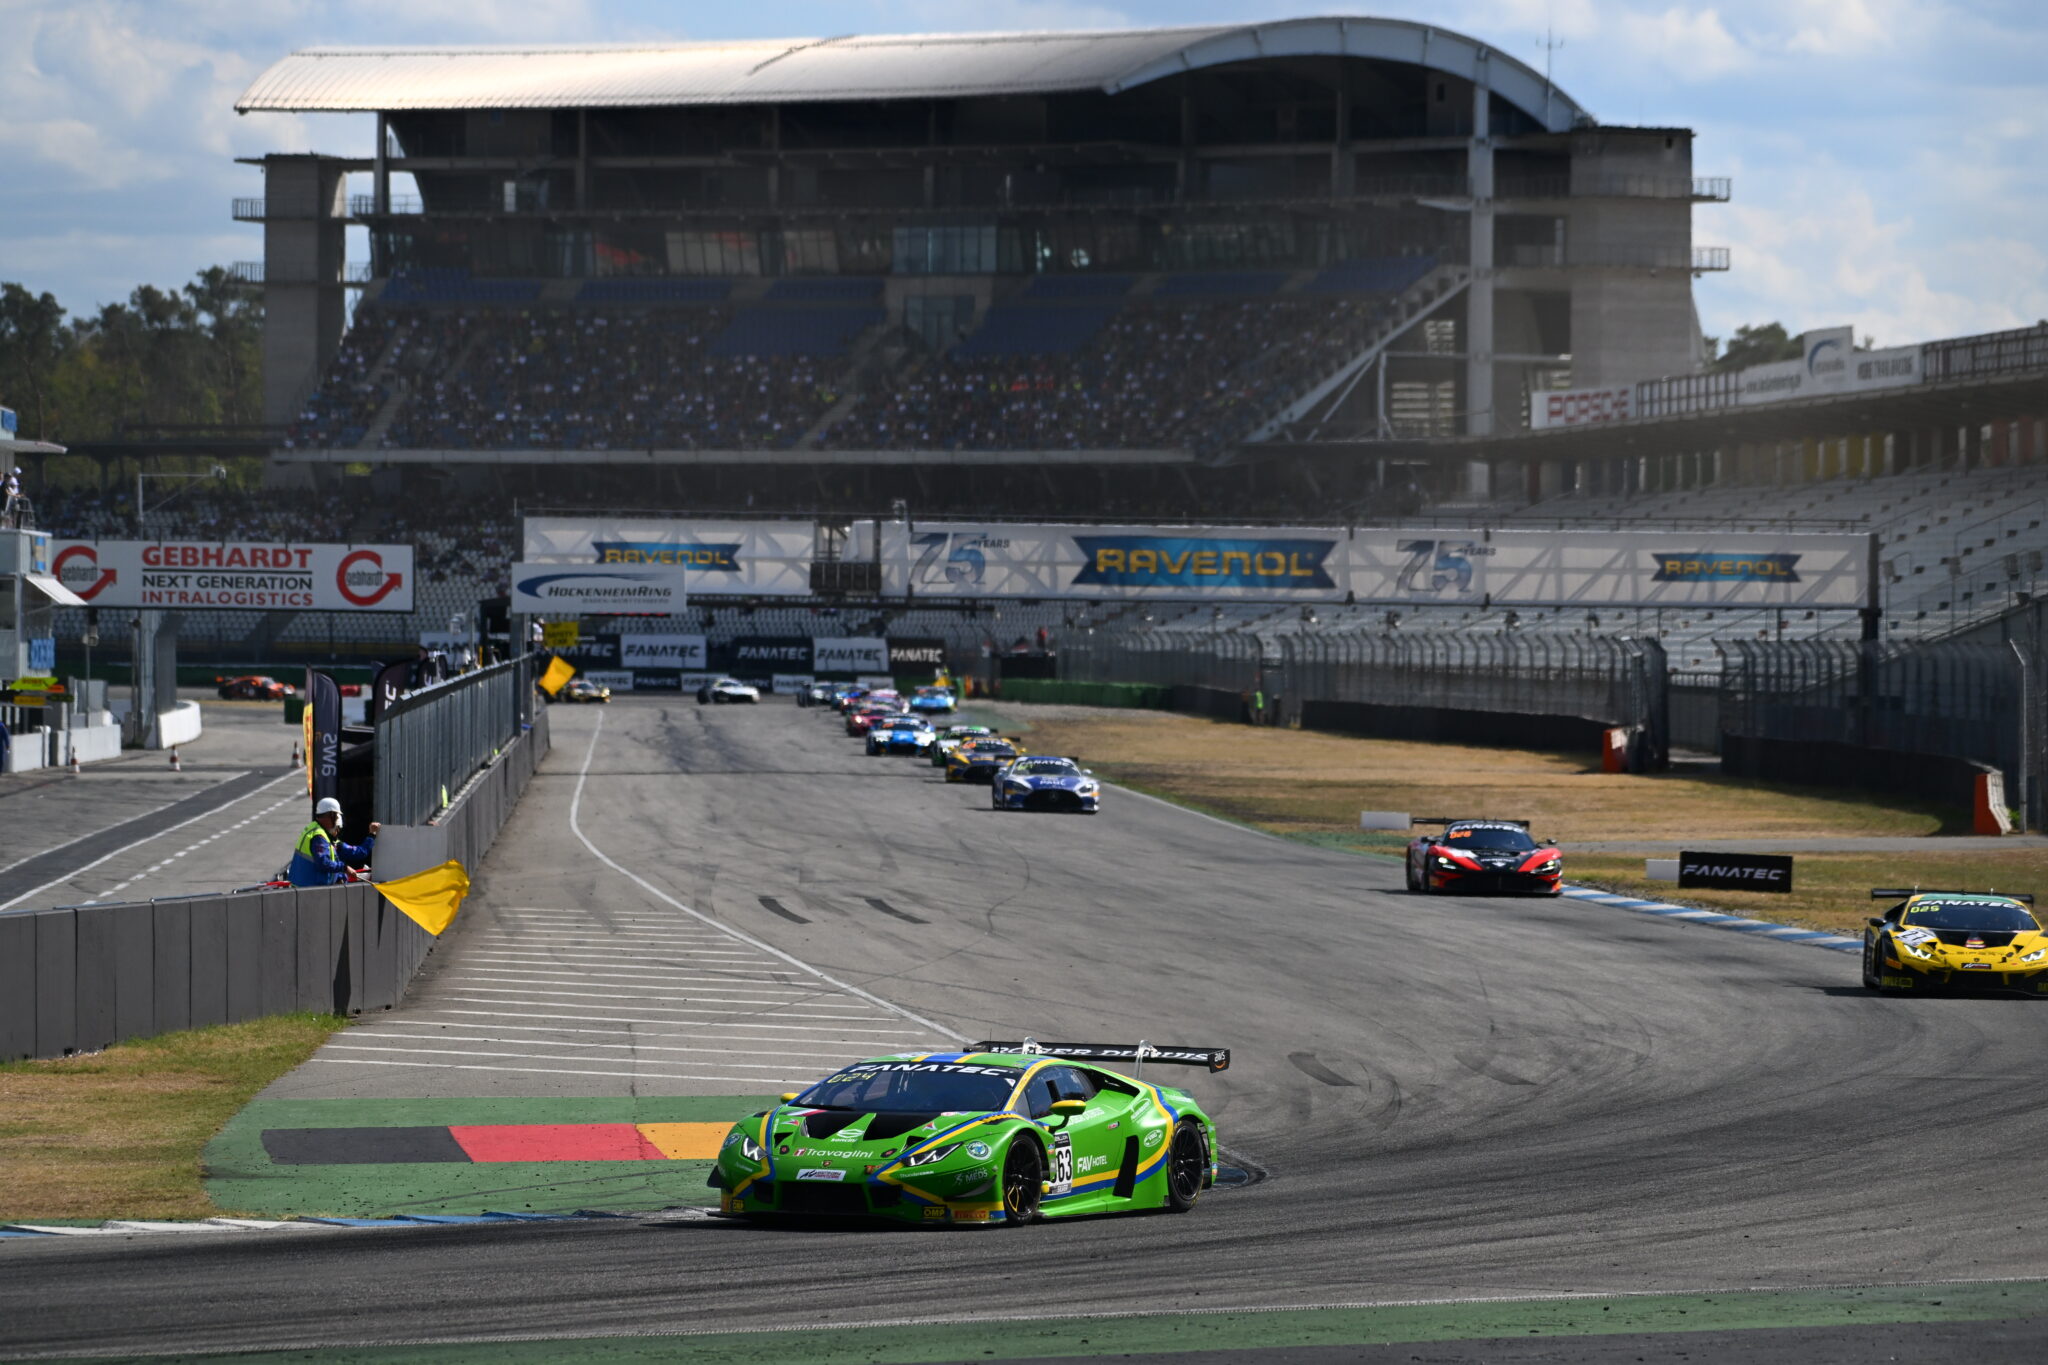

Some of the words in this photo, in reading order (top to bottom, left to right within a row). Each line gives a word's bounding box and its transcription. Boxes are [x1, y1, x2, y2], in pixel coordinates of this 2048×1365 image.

[142, 546, 313, 569] GEBHARDT
[605, 548, 729, 565] RAVENOL
[1096, 548, 1314, 577] RAVENOL
[1664, 560, 1789, 576] RAVENOL
[142, 574, 191, 588] NEXT
[197, 575, 312, 590] GENERATION
[345, 569, 384, 587] gebhardt
[142, 591, 312, 606] INTRALOGISTICS
[625, 644, 699, 658] FANATEC
[737, 646, 808, 660] FANATEC
[816, 647, 882, 661] FANATEC
[891, 649, 942, 663] FANATEC
[1452, 823, 1524, 834] FANATEC
[1682, 864, 1783, 881] FANATEC
[1917, 899, 2018, 910] FANATEC
[849, 1064, 1009, 1076] FANATEC
[827, 1071, 877, 1084] 024
[807, 1149, 873, 1158] Travaglini
[1077, 1156, 1093, 1173] FAV
[1093, 1155, 1108, 1166] HOTEL
[923, 1207, 945, 1217] OMP
